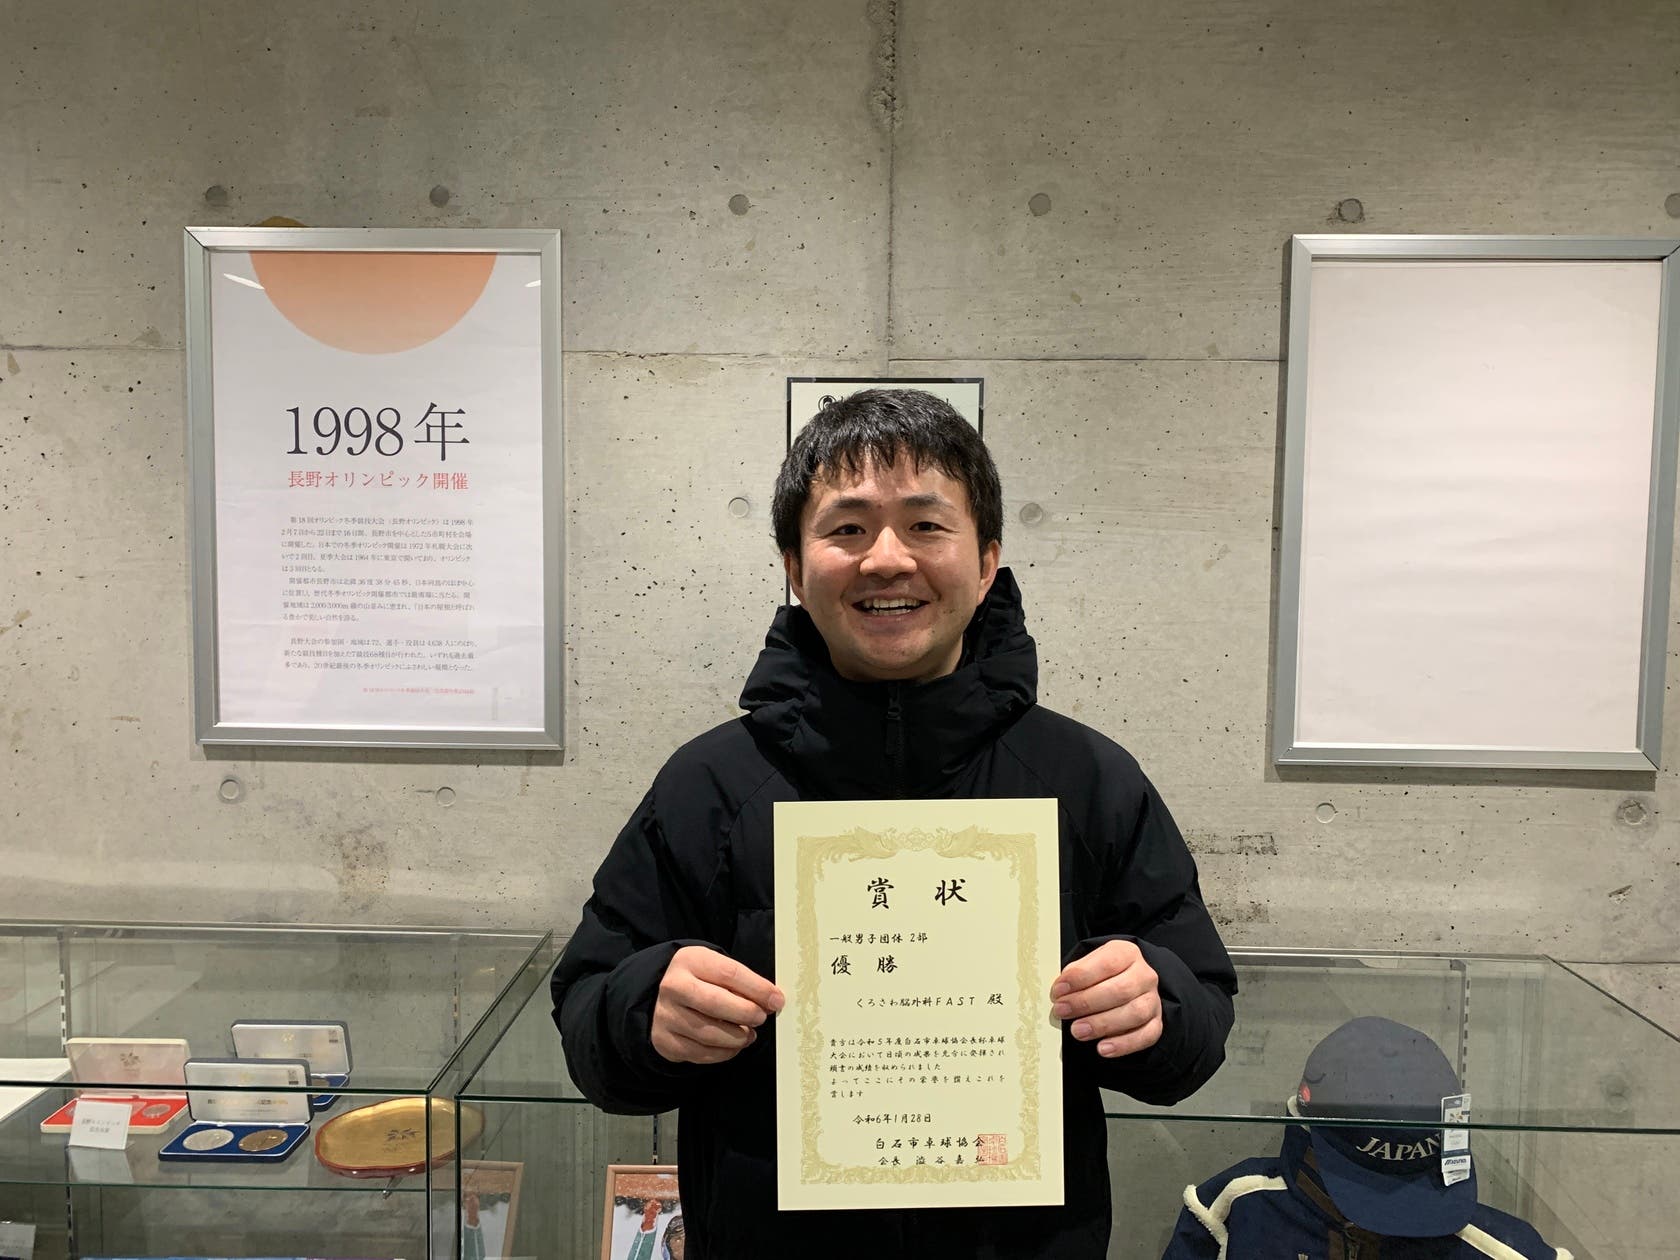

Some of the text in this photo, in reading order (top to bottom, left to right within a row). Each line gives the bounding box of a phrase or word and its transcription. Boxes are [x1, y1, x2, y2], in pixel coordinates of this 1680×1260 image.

[286, 402, 470, 461] 1998年
[288, 470, 469, 490] 長野オリンピック開催
[867, 877, 968, 909] 賞状
[829, 932, 904, 945] 一般男子団体
[831, 954, 898, 975] 優勝
[986, 993, 1004, 1006] 殿
[852, 1114, 932, 1124] 令和6年1月28日
[876, 1136, 985, 1150] 白石市卓球協会
[1356, 1133, 1441, 1161] JAPAN
